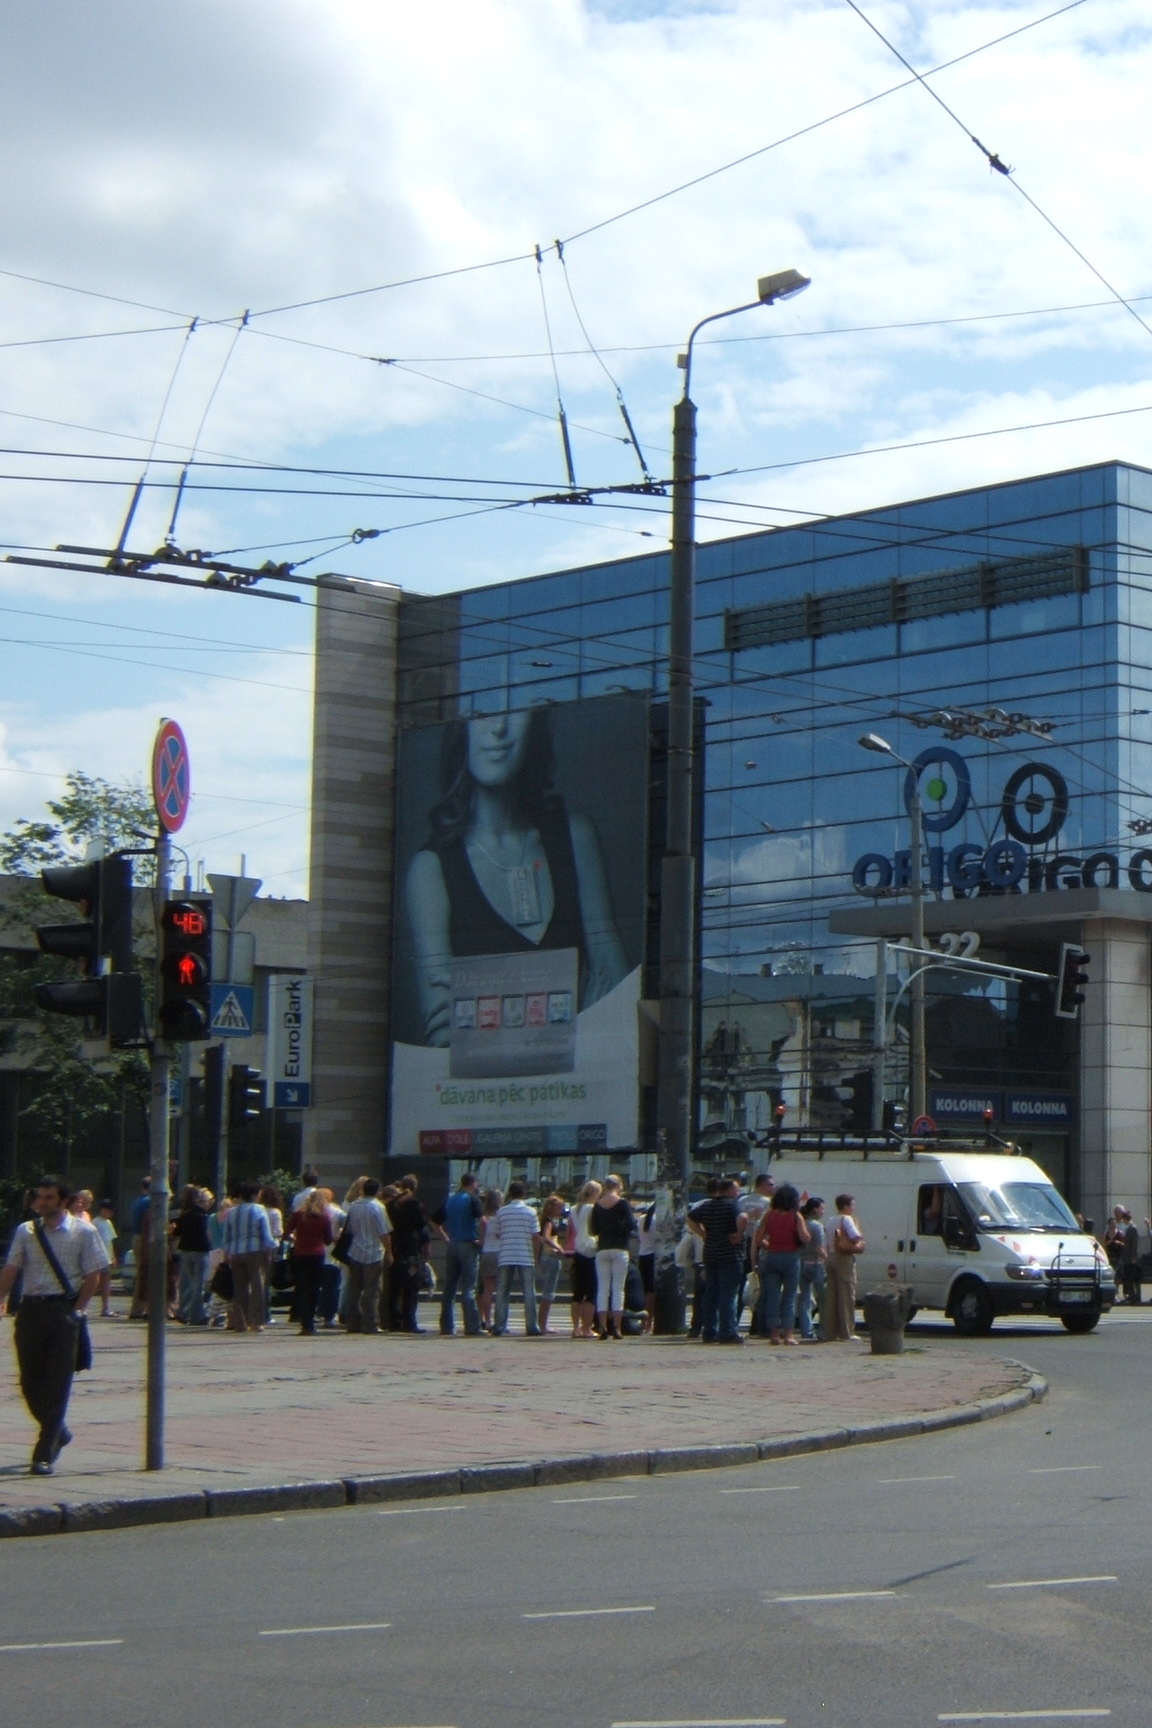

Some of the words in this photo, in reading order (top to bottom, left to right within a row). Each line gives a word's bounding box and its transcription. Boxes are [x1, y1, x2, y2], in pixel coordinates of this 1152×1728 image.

[285, 980, 301, 1077] EuroPark
[439, 1085, 495, 1105] dāvana
[499, 1083, 525, 1107] pēc
[529, 1081, 588, 1106] patikas
[936, 1098, 993, 1113] KOLONNA
[1012, 1101, 1067, 1115] KOLONNA
[580, 1129, 606, 1141] ORIGO
